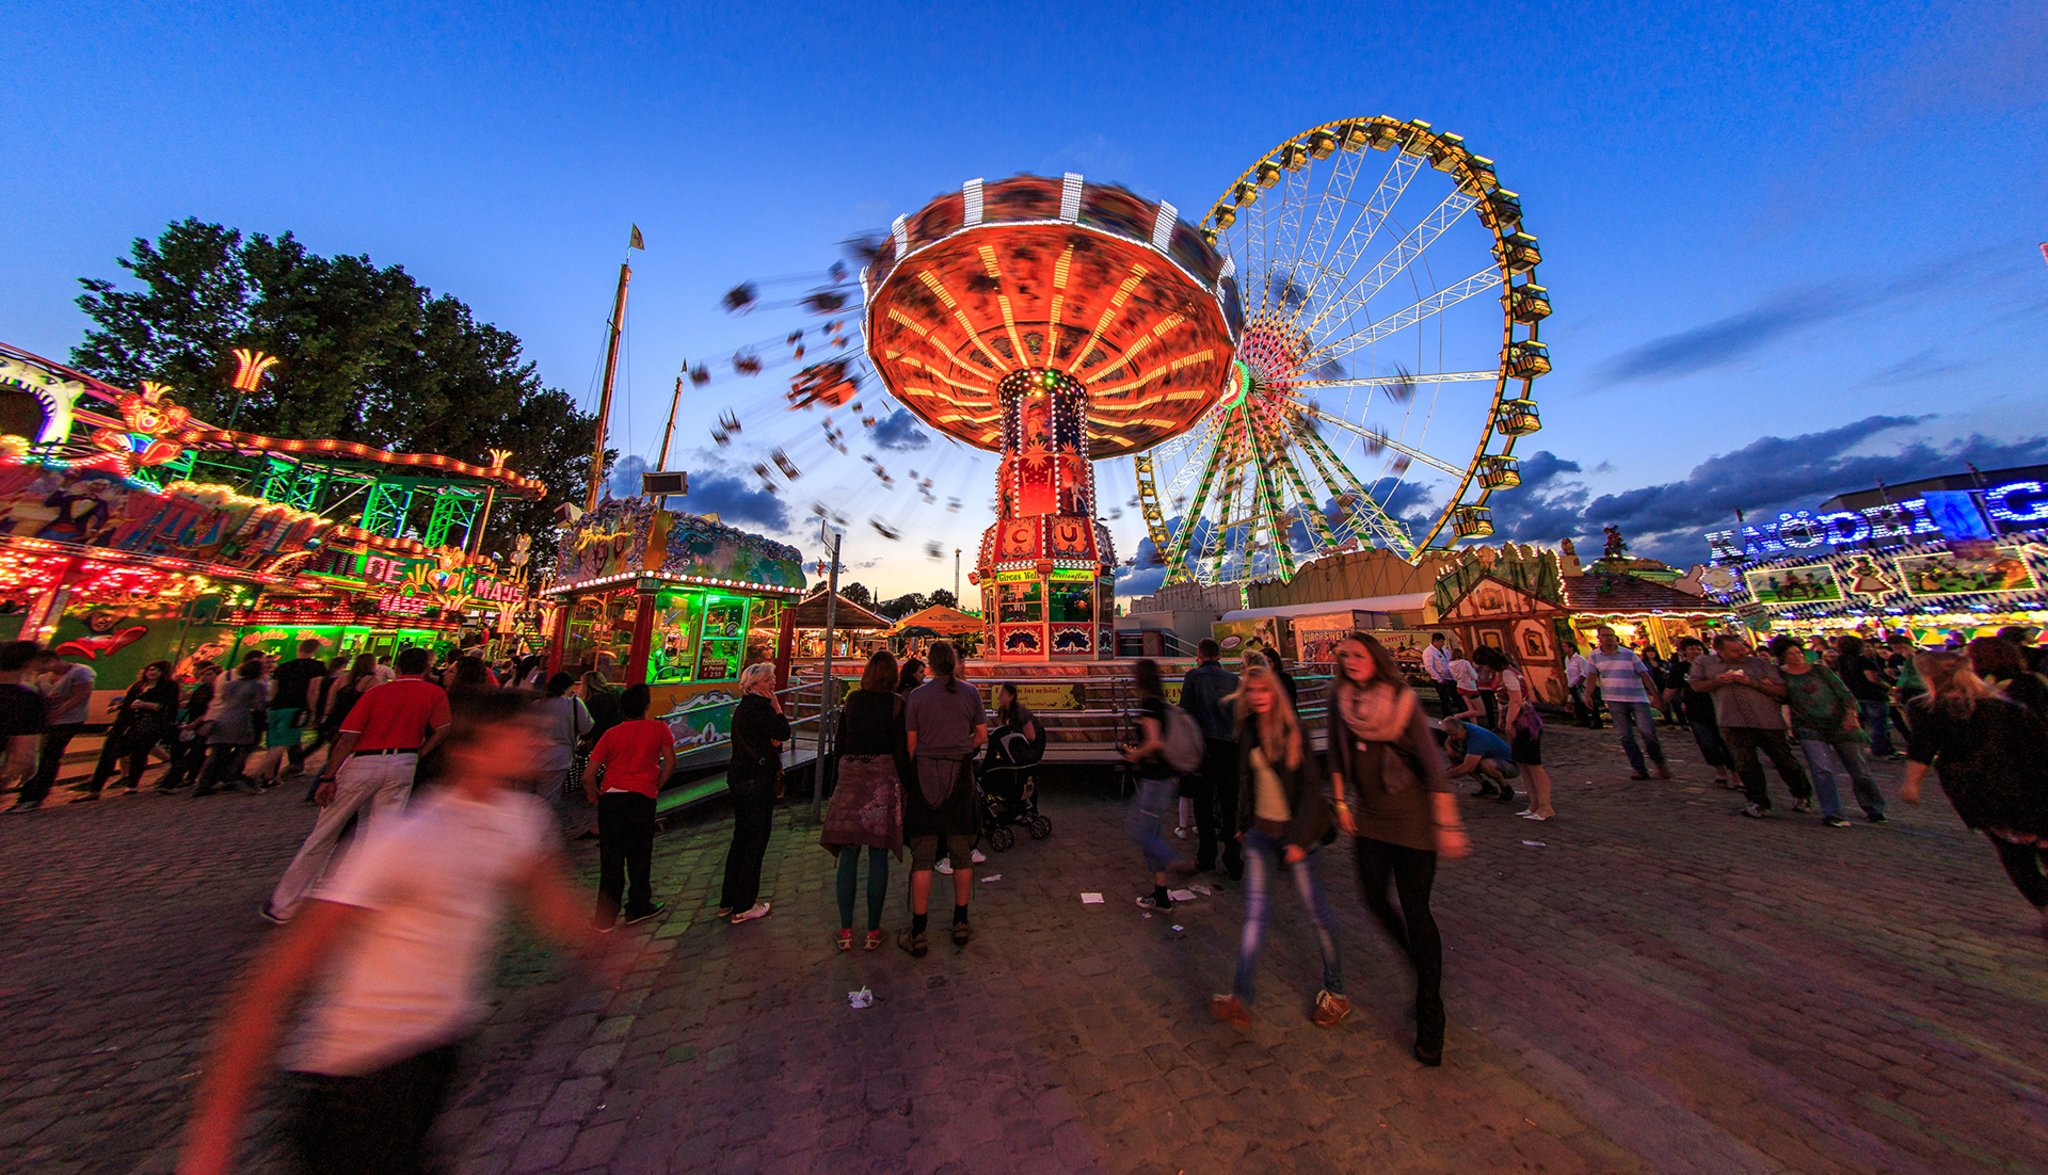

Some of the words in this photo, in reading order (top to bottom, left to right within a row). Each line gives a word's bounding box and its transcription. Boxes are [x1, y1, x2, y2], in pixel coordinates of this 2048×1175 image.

[1012, 529, 1029, 544] C
[1060, 526, 1078, 543] U
[474, 578, 525, 603] MAUS
[379, 594, 429, 615] KASSE
